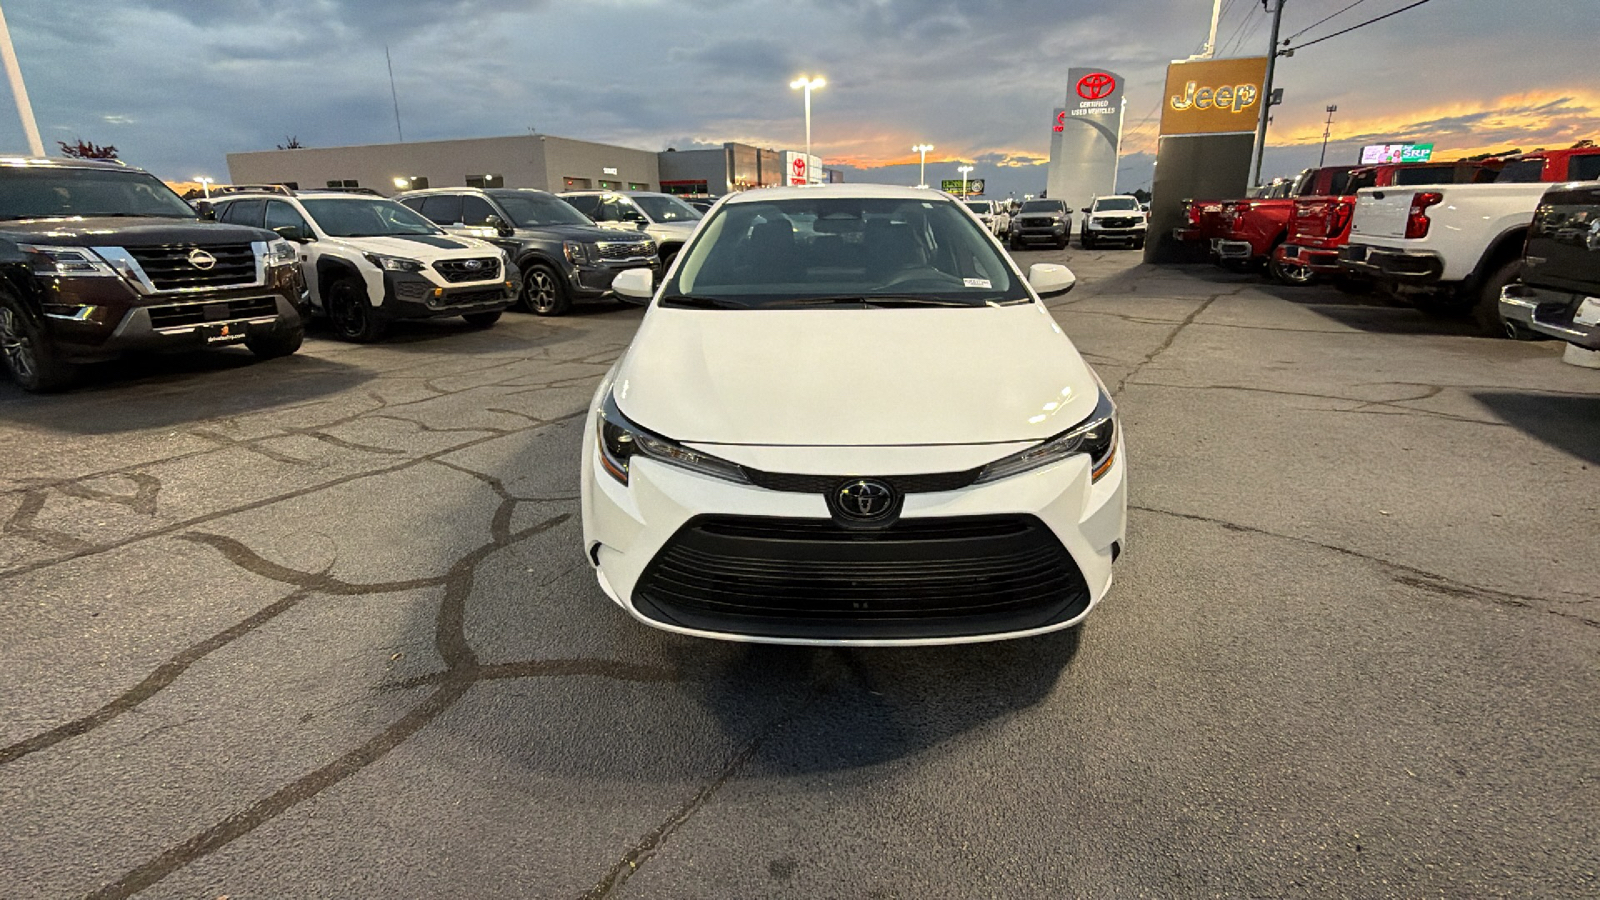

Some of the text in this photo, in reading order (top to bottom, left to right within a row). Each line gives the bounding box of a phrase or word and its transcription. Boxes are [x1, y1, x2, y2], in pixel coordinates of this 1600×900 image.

[1171, 81, 1257, 113] Jeep
[1080, 100, 1109, 108] CERTIFIED
[1071, 107, 1116, 116] USED VEHICLES
[1403, 149, 1431, 157] SRP
